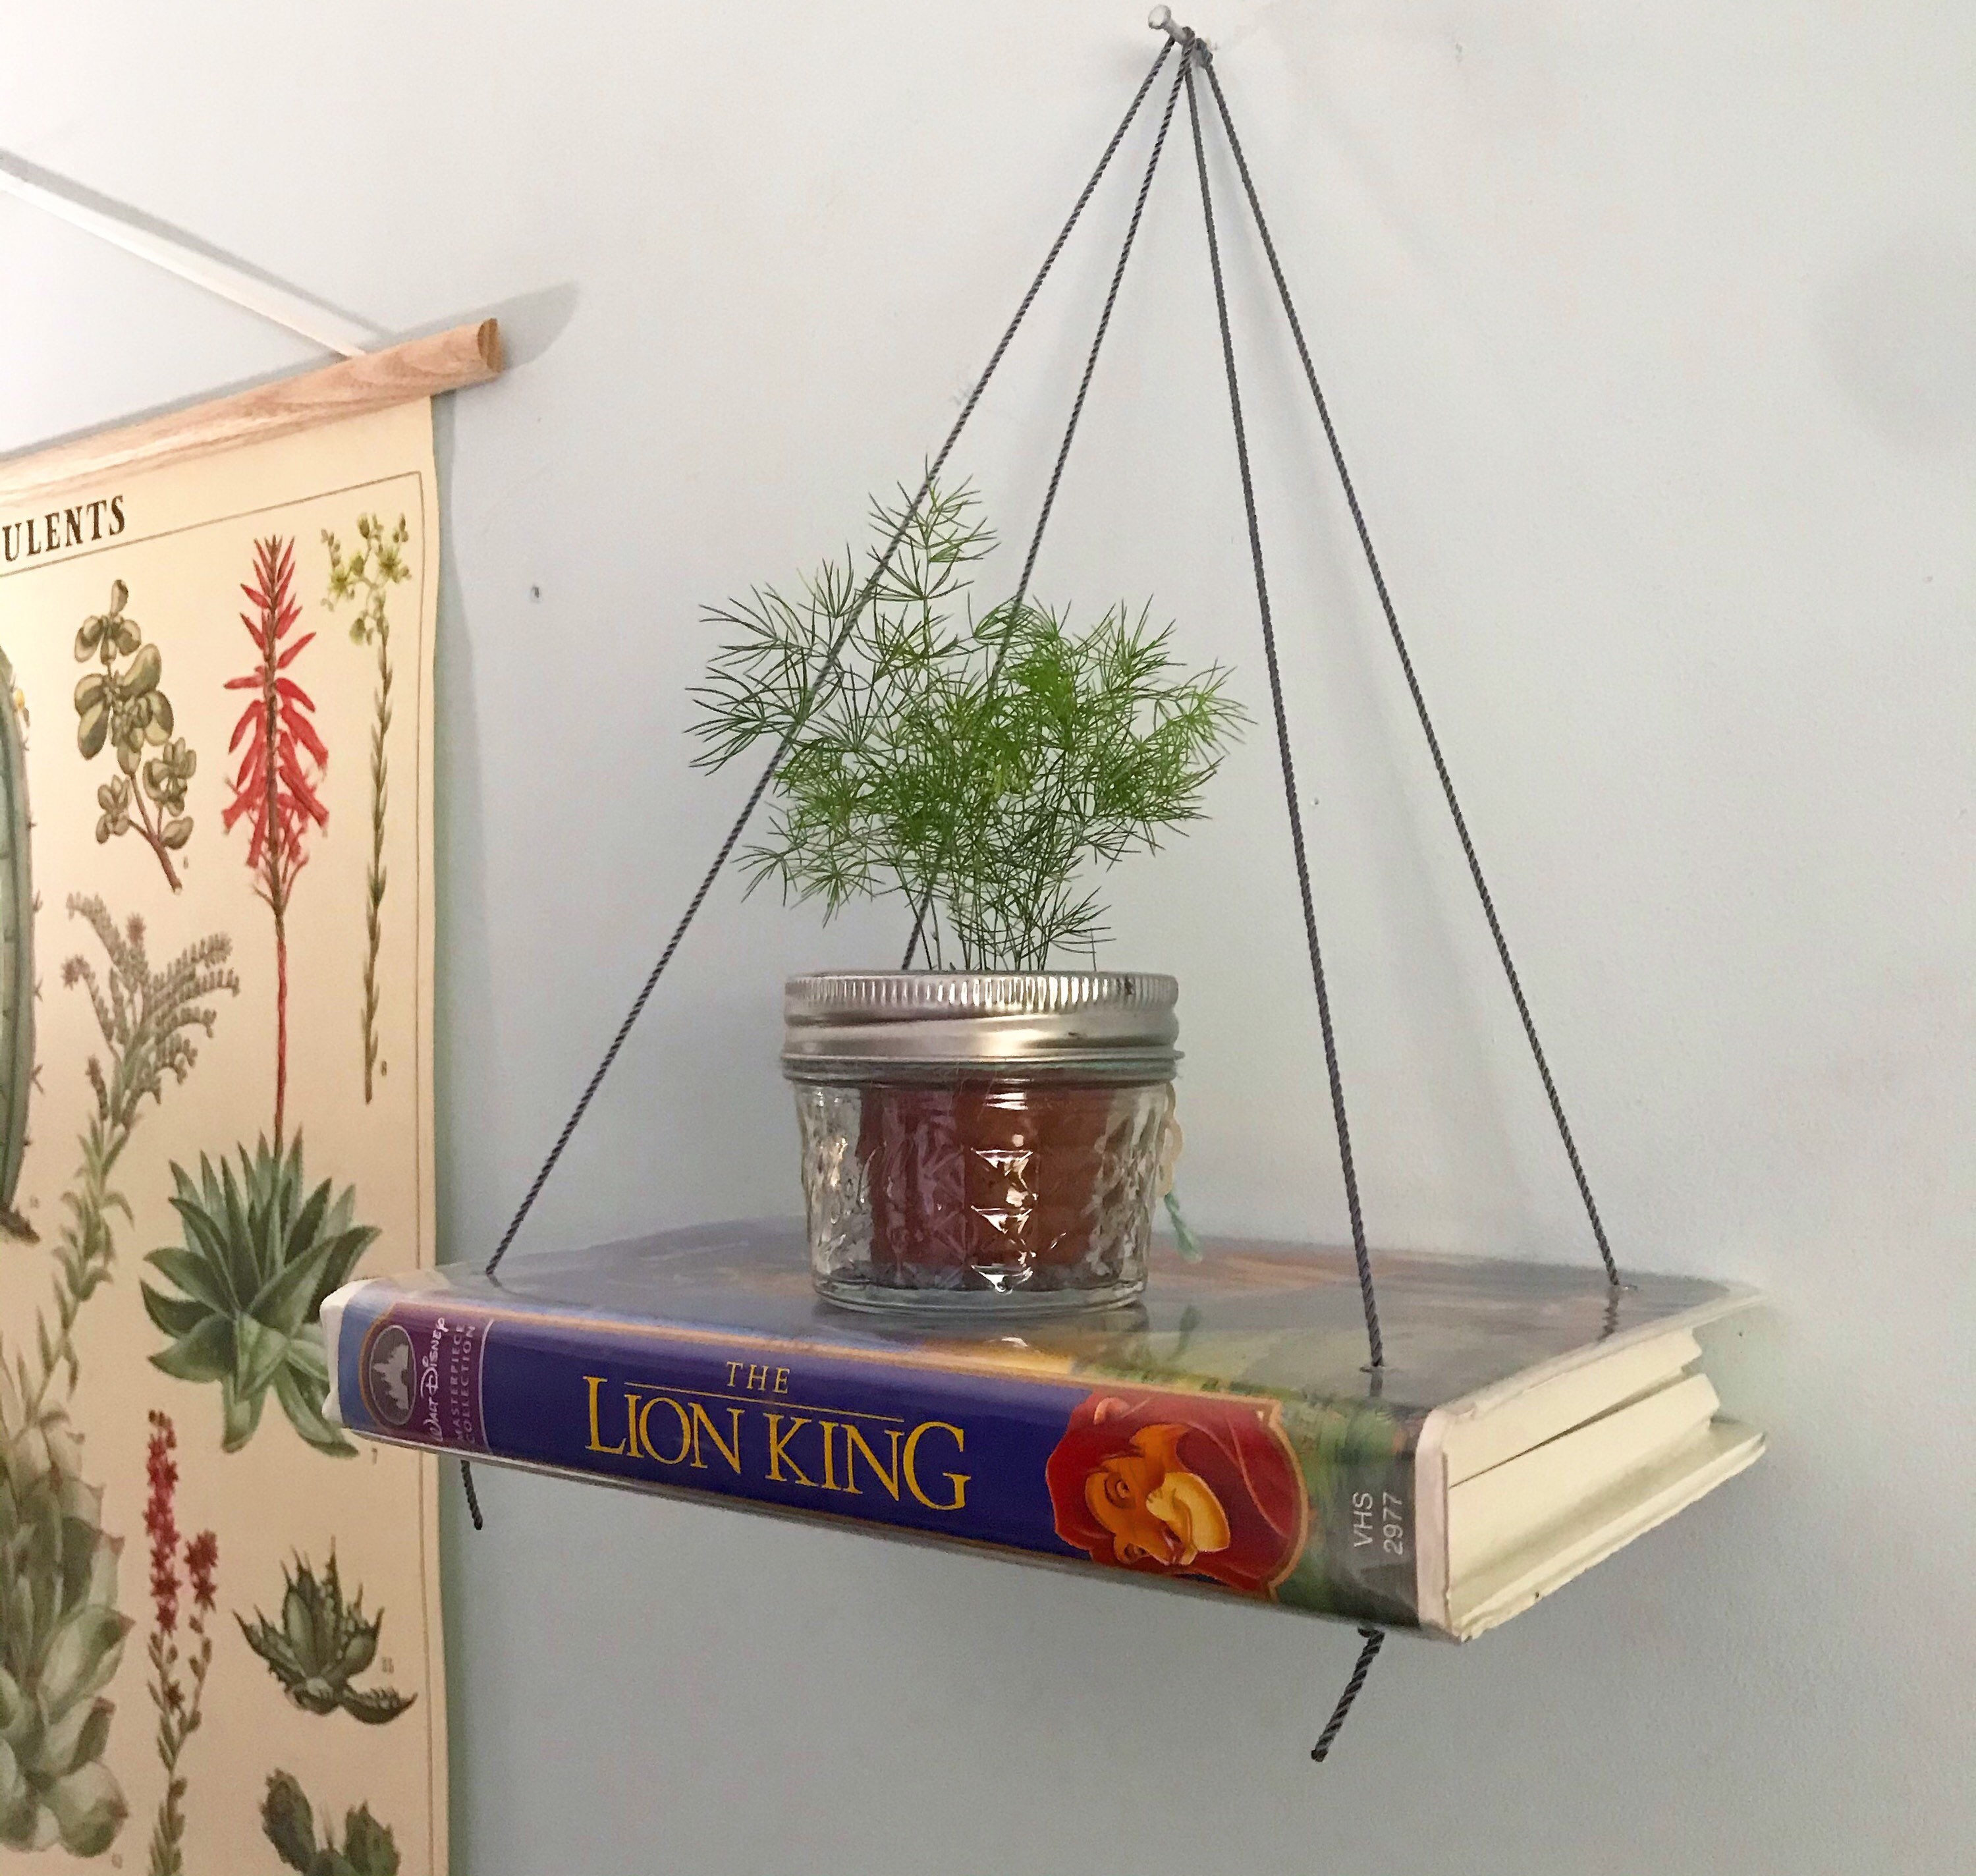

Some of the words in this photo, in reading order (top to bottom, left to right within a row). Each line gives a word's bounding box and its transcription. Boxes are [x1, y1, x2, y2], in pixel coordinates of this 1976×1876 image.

[2, 494, 125, 562] ULENTS
[450, 1324, 466, 1441] MASTERPIECE
[462, 1325, 476, 1444] COLLECTION
[726, 1361, 790, 1394] THE
[582, 1375, 746, 1474] LION
[763, 1413, 972, 1510] KING
[1352, 1491, 1373, 1547] VHS
[1383, 1491, 1404, 1556] 2977
